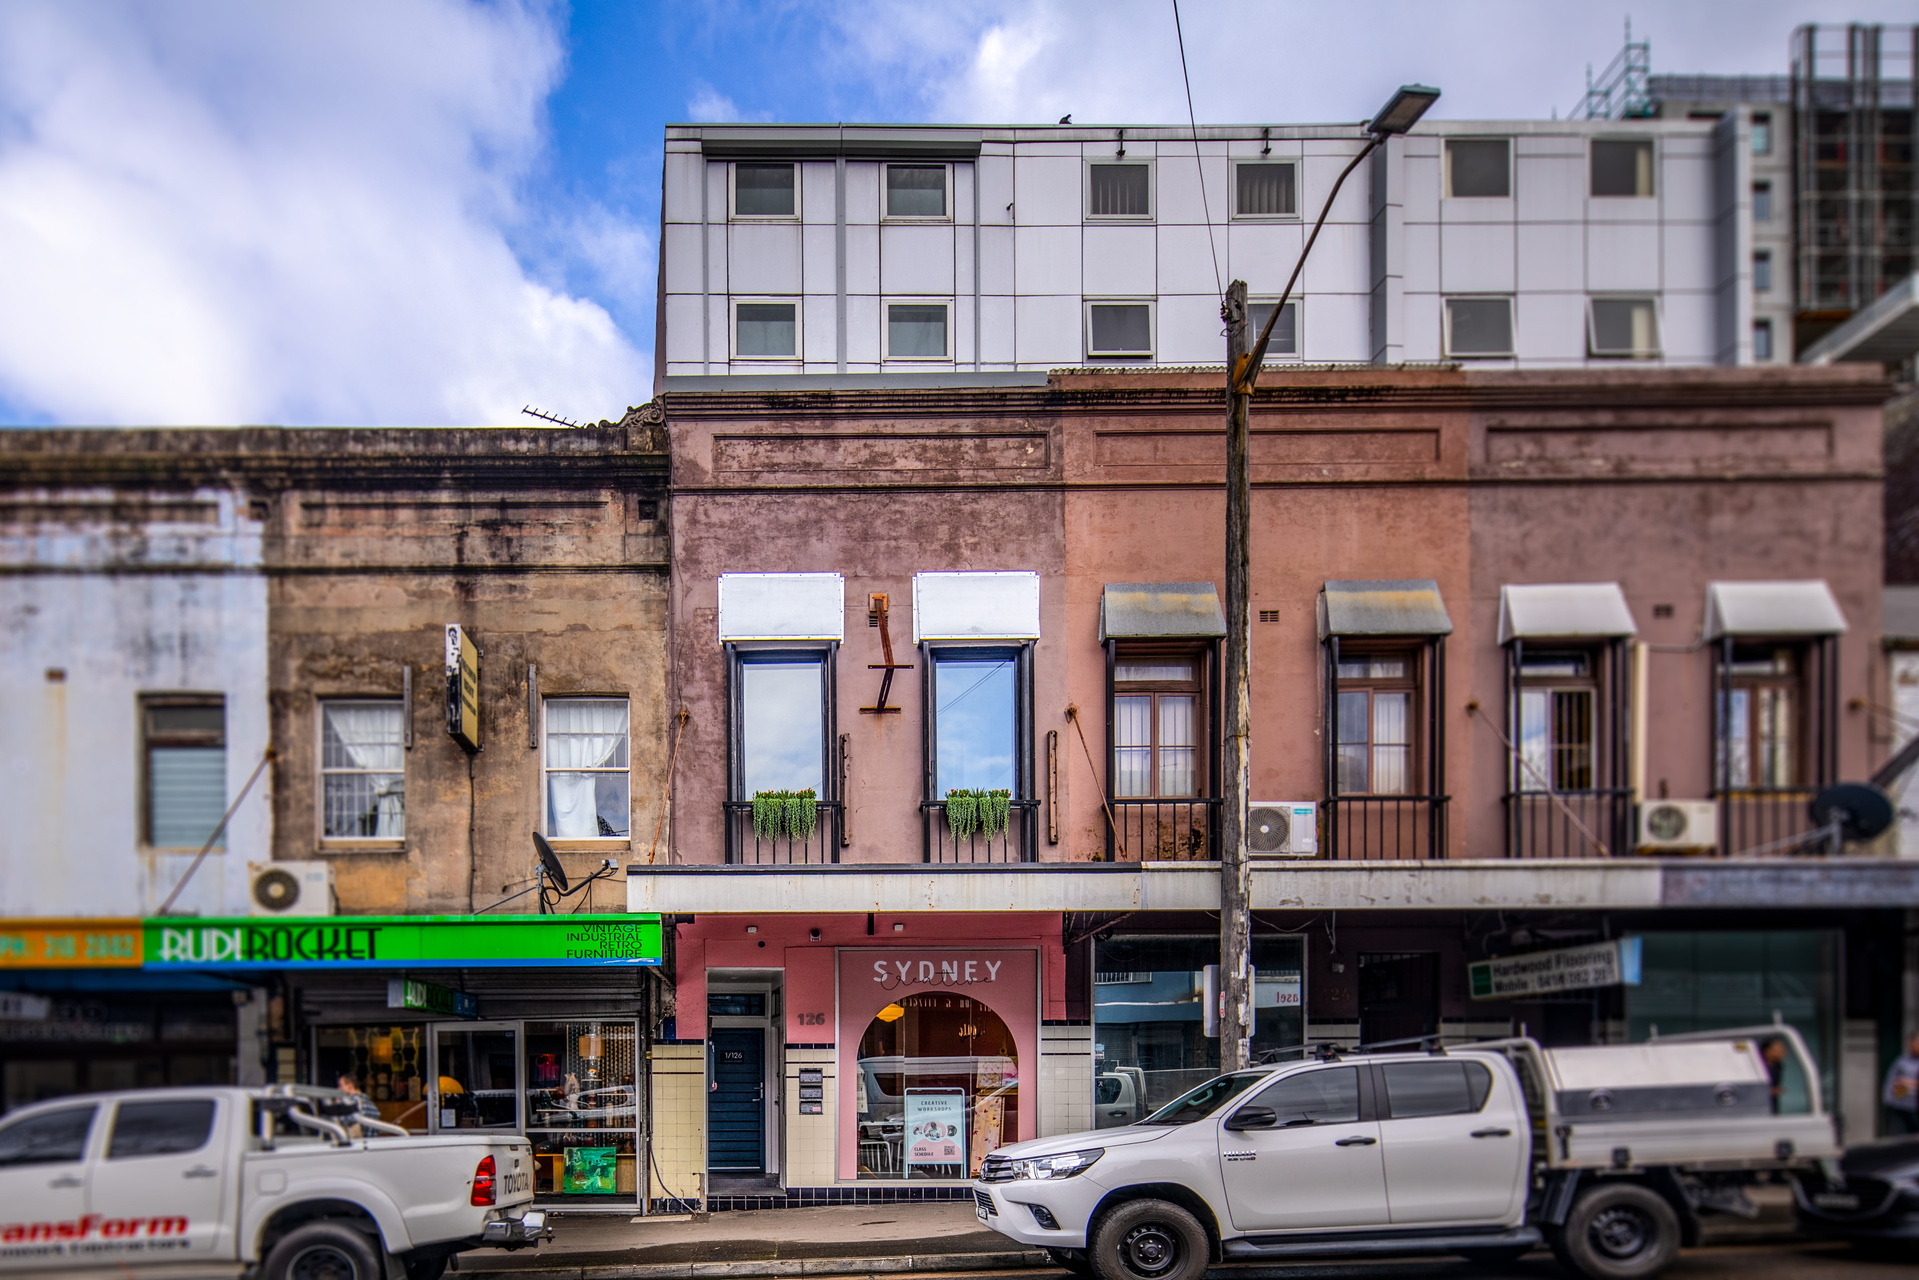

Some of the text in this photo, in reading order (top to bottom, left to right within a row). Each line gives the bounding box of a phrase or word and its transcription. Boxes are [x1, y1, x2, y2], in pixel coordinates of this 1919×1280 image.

[582, 924, 642, 933] VINTAGE
[158, 927, 383, 962] RUDI ROCKET
[566, 933, 643, 942] INDUSTRIAL
[599, 941, 643, 950] RETRO
[566, 949, 642, 959] FURNITURE
[873, 960, 1002, 982] SYDNEY
[797, 1012, 826, 1026] 126
[504, 1172, 529, 1195] TOYOTA
[0, 1213, 190, 1245] ansForm
